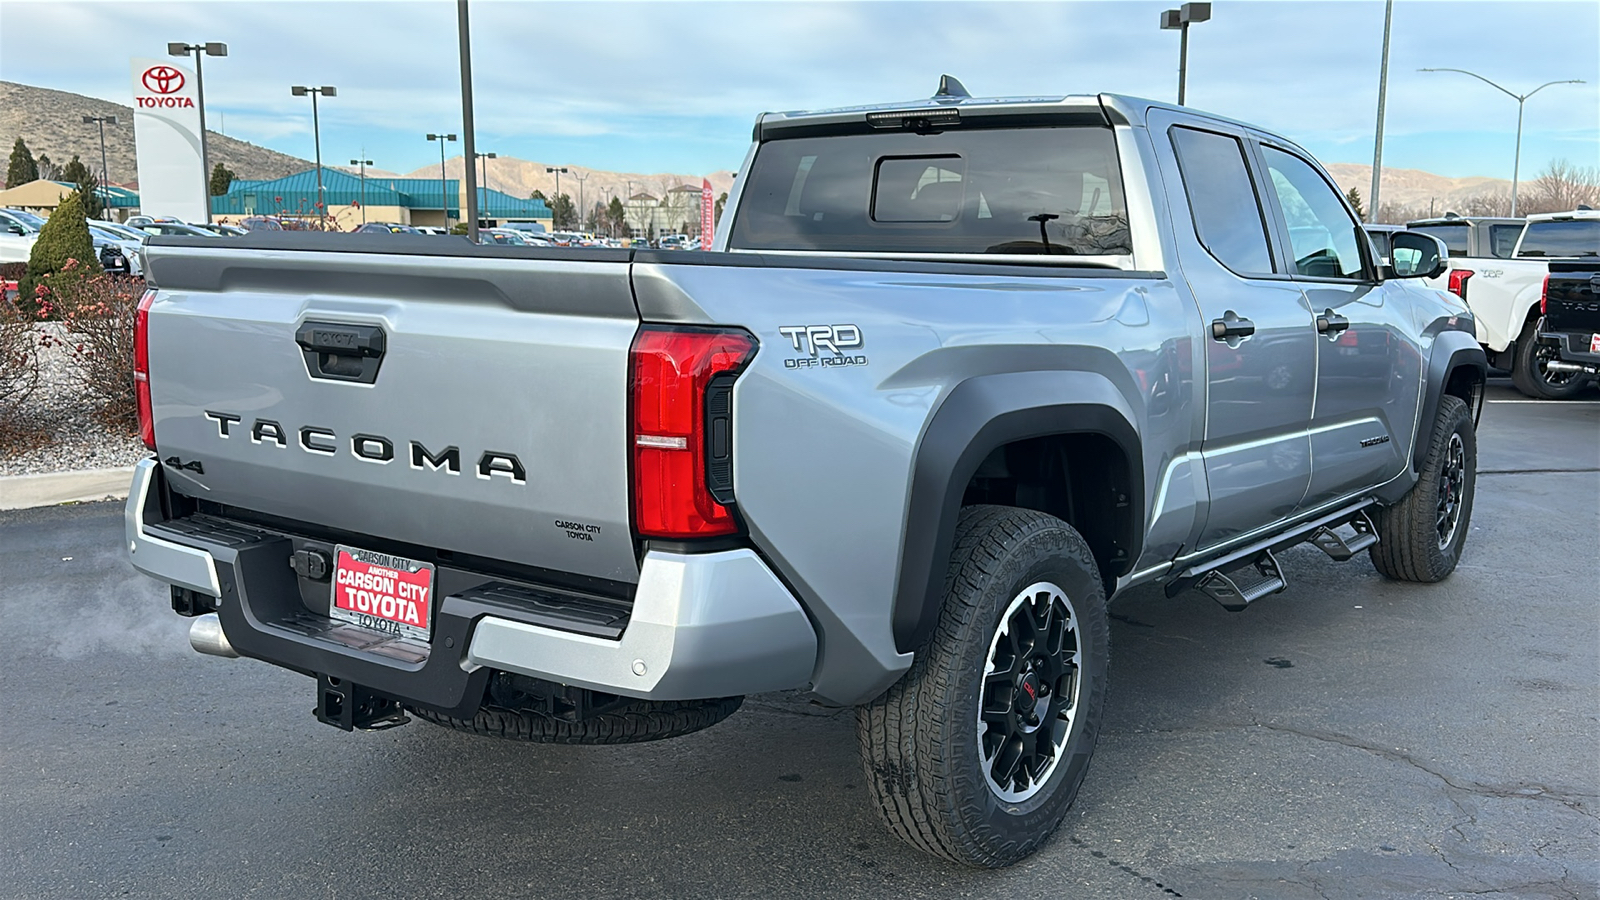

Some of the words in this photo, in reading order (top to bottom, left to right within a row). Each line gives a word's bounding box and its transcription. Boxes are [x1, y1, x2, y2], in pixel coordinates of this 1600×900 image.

[136, 97, 194, 108] TOYOTA
[316, 332, 354, 346] TOYOTA
[779, 324, 864, 357] TRD
[784, 358, 819, 369] OFF
[821, 356, 868, 368] ROAD
[204, 410, 526, 485] TACOMA
[554, 519, 585, 531] CARSON
[585, 524, 601, 534] CITY
[566, 530, 594, 541] TOYOTA
[357, 549, 390, 567] CARSON
[392, 557, 411, 571] CITY
[368, 566, 399, 580] ANOTHER
[337, 568, 394, 595] CARSON
[398, 581, 429, 602] CITY
[345, 587, 419, 624] TOYOTA
[357, 613, 403, 636] TOYOTA
